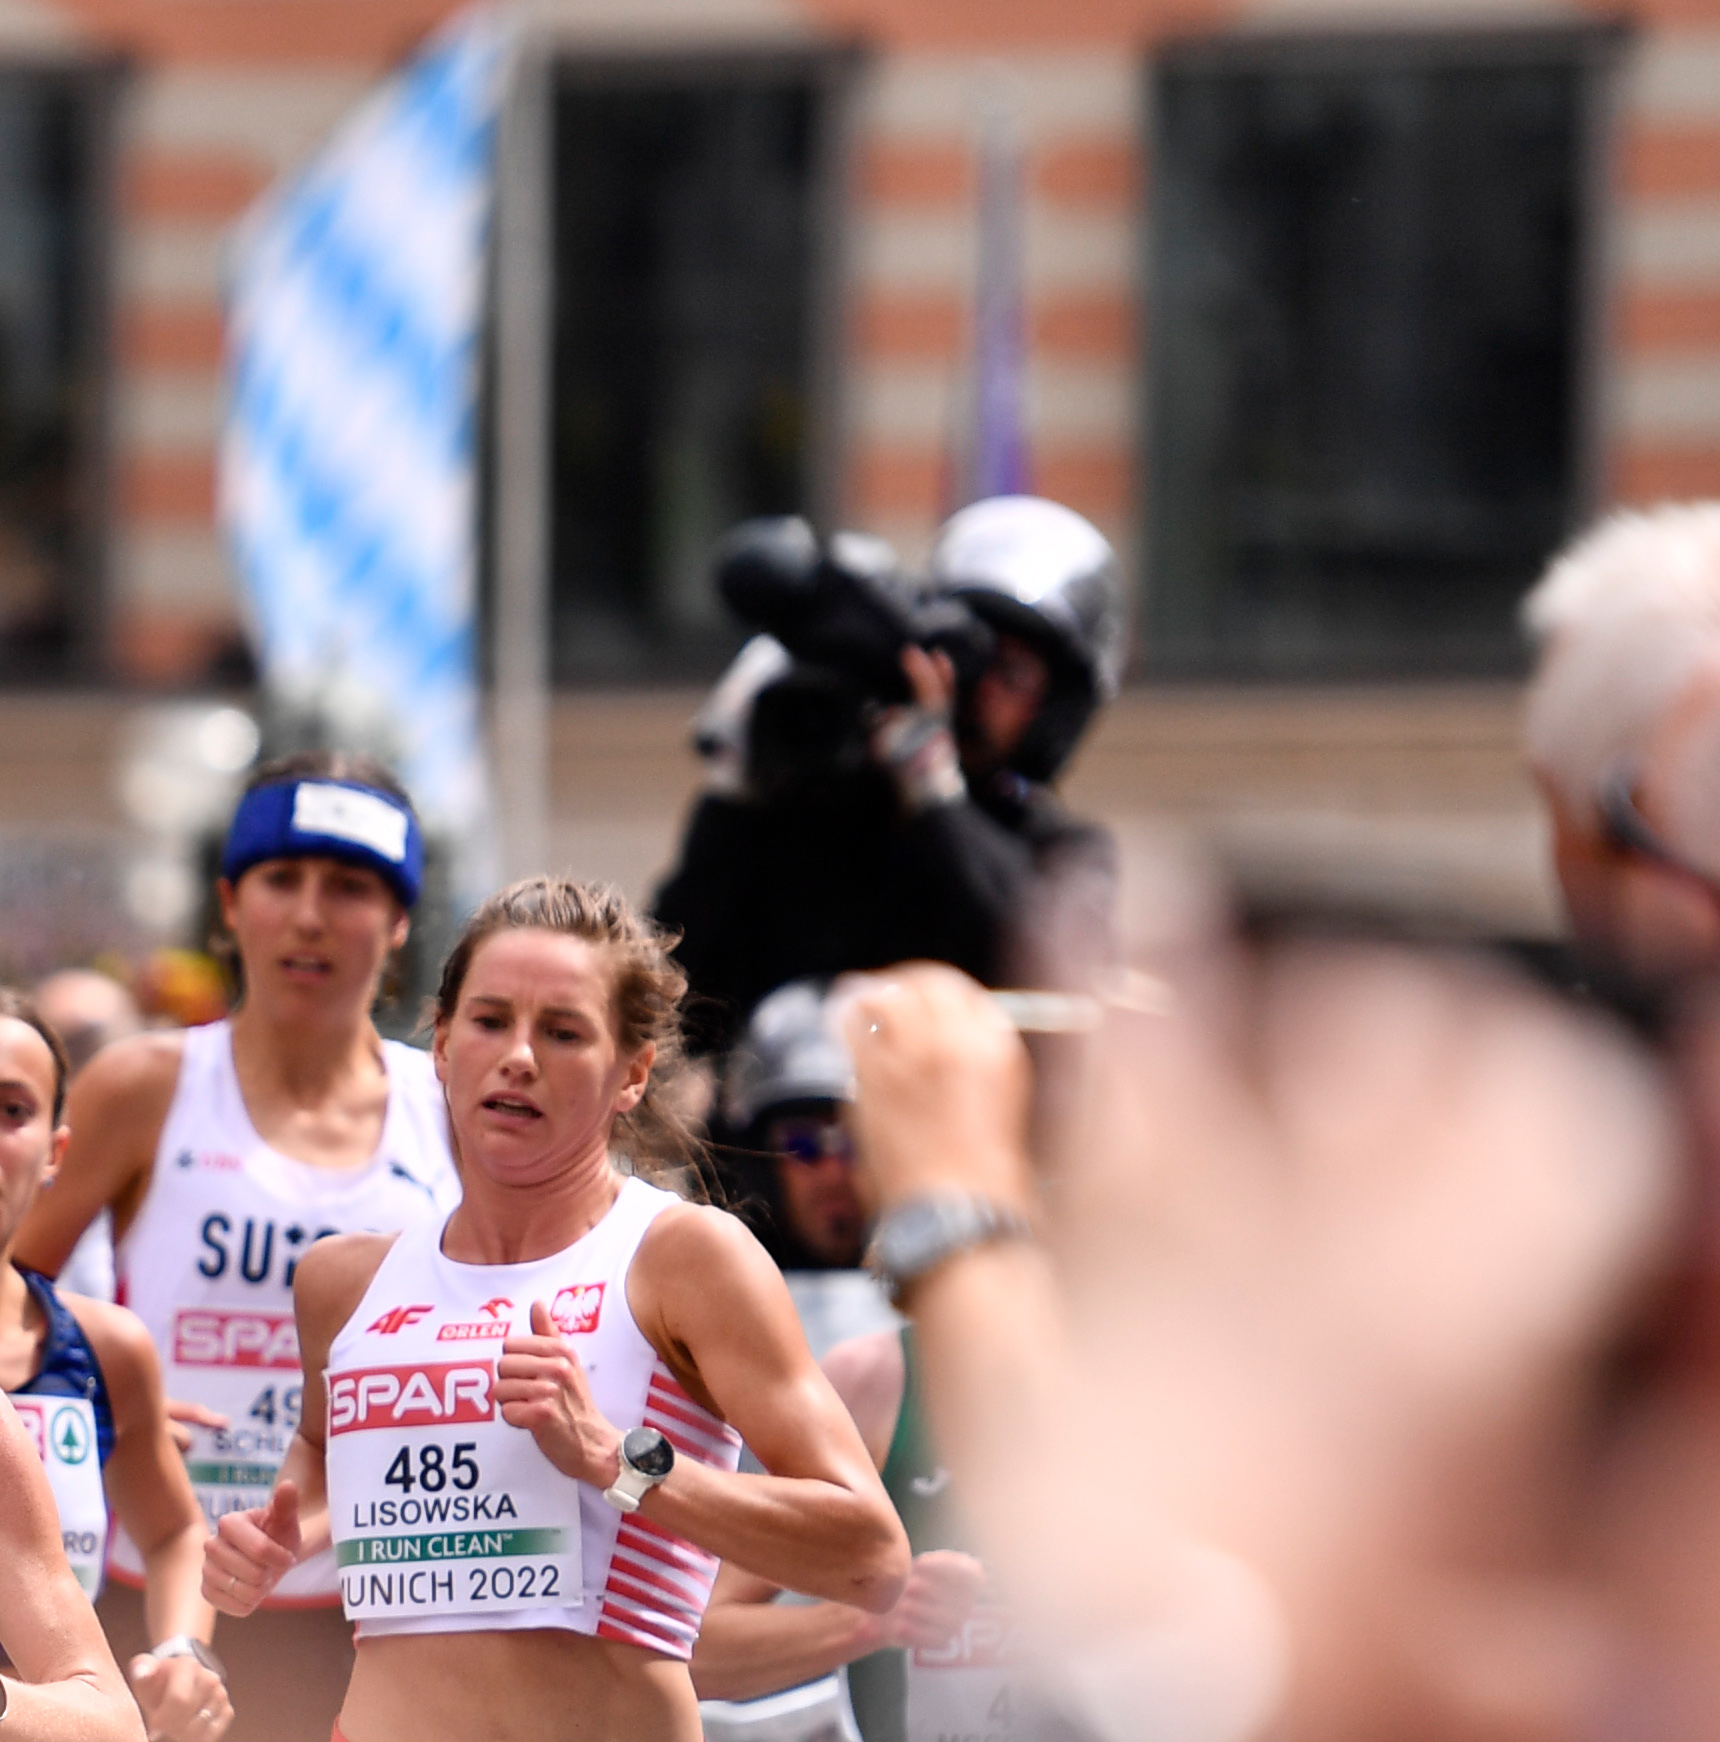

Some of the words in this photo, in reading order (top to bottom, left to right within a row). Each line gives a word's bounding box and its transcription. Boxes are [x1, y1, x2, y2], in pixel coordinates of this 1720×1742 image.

[440, 1322, 506, 1339] ORLEN
[331, 1366, 491, 1428] SPAR
[384, 1442, 480, 1494] 485
[353, 1493, 518, 1528] LISOWSKA
[359, 1543, 364, 1561] I
[371, 1537, 422, 1561] RUN
[341, 1569, 454, 1608] UNICH
[469, 1564, 561, 1601] 2022
